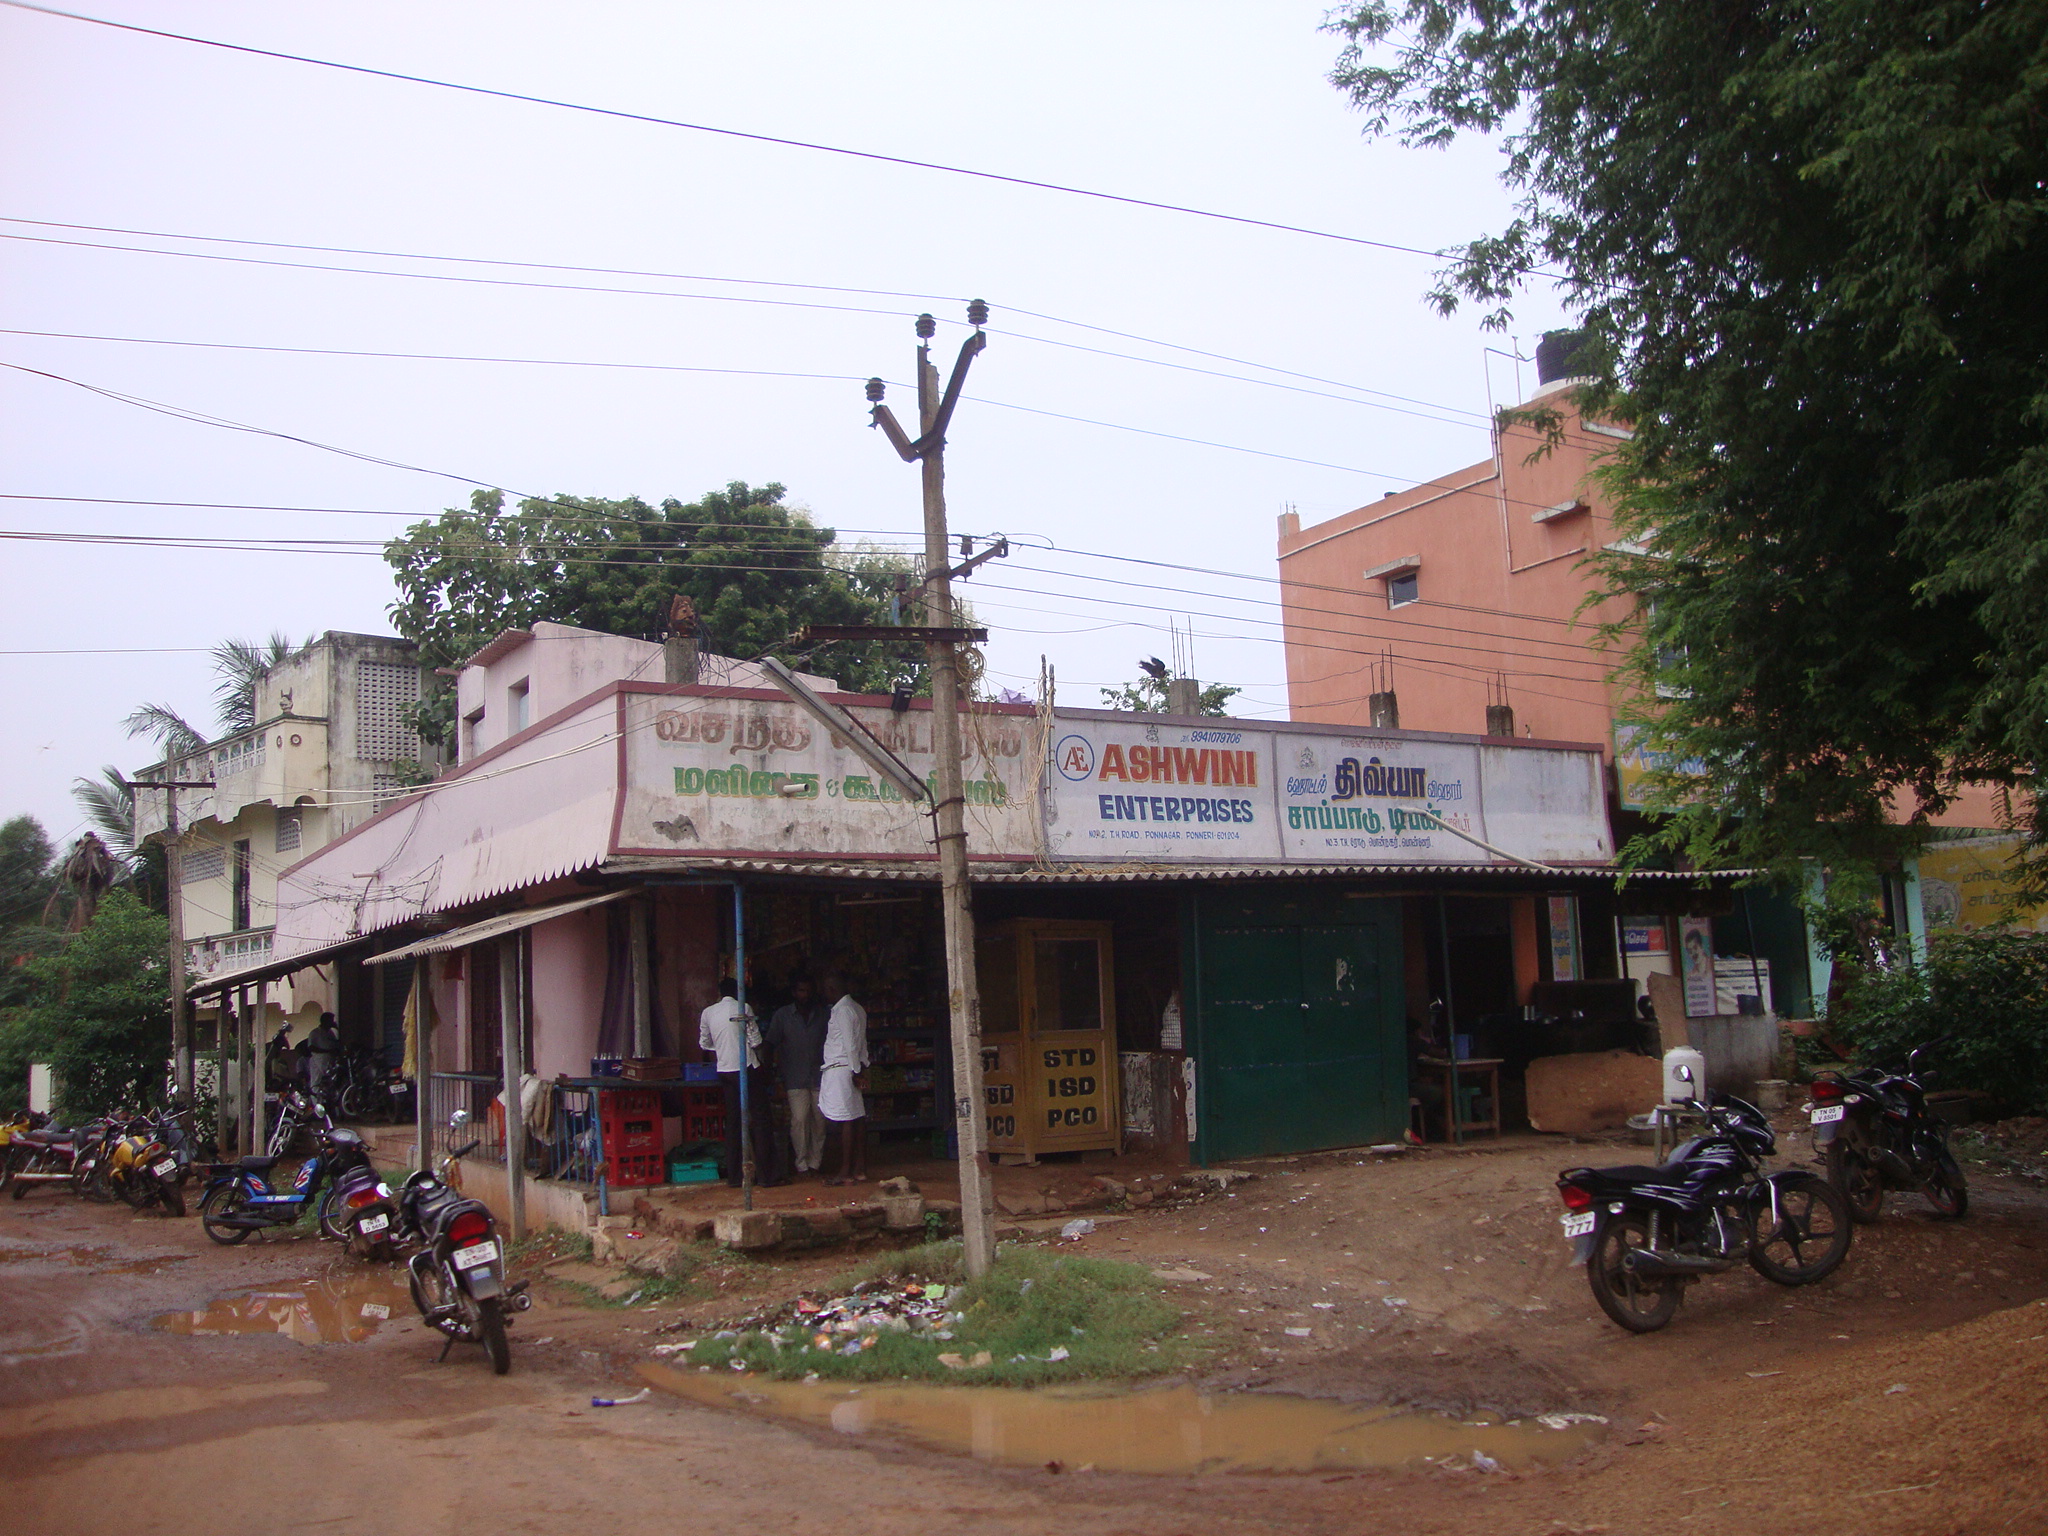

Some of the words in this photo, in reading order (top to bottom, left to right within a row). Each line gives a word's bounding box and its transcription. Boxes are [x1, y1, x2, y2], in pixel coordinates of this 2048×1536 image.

[1190, 730, 1242, 744] 9941079706
[1098, 743, 1258, 788] ASHWINI
[1287, 774, 1328, 797] ஹோட்டல்
[1331, 756, 1427, 801] திவ்யா
[1428, 779, 1463, 802] விஹார்
[1098, 794, 1254, 823] ENTERPRISES
[1044, 1048, 1096, 1068] STD
[983, 1084, 1014, 1105] SD
[1048, 1076, 1096, 1097] ISD
[1048, 1106, 1097, 1128] PCO
[1567, 1221, 1592, 1235] 777
